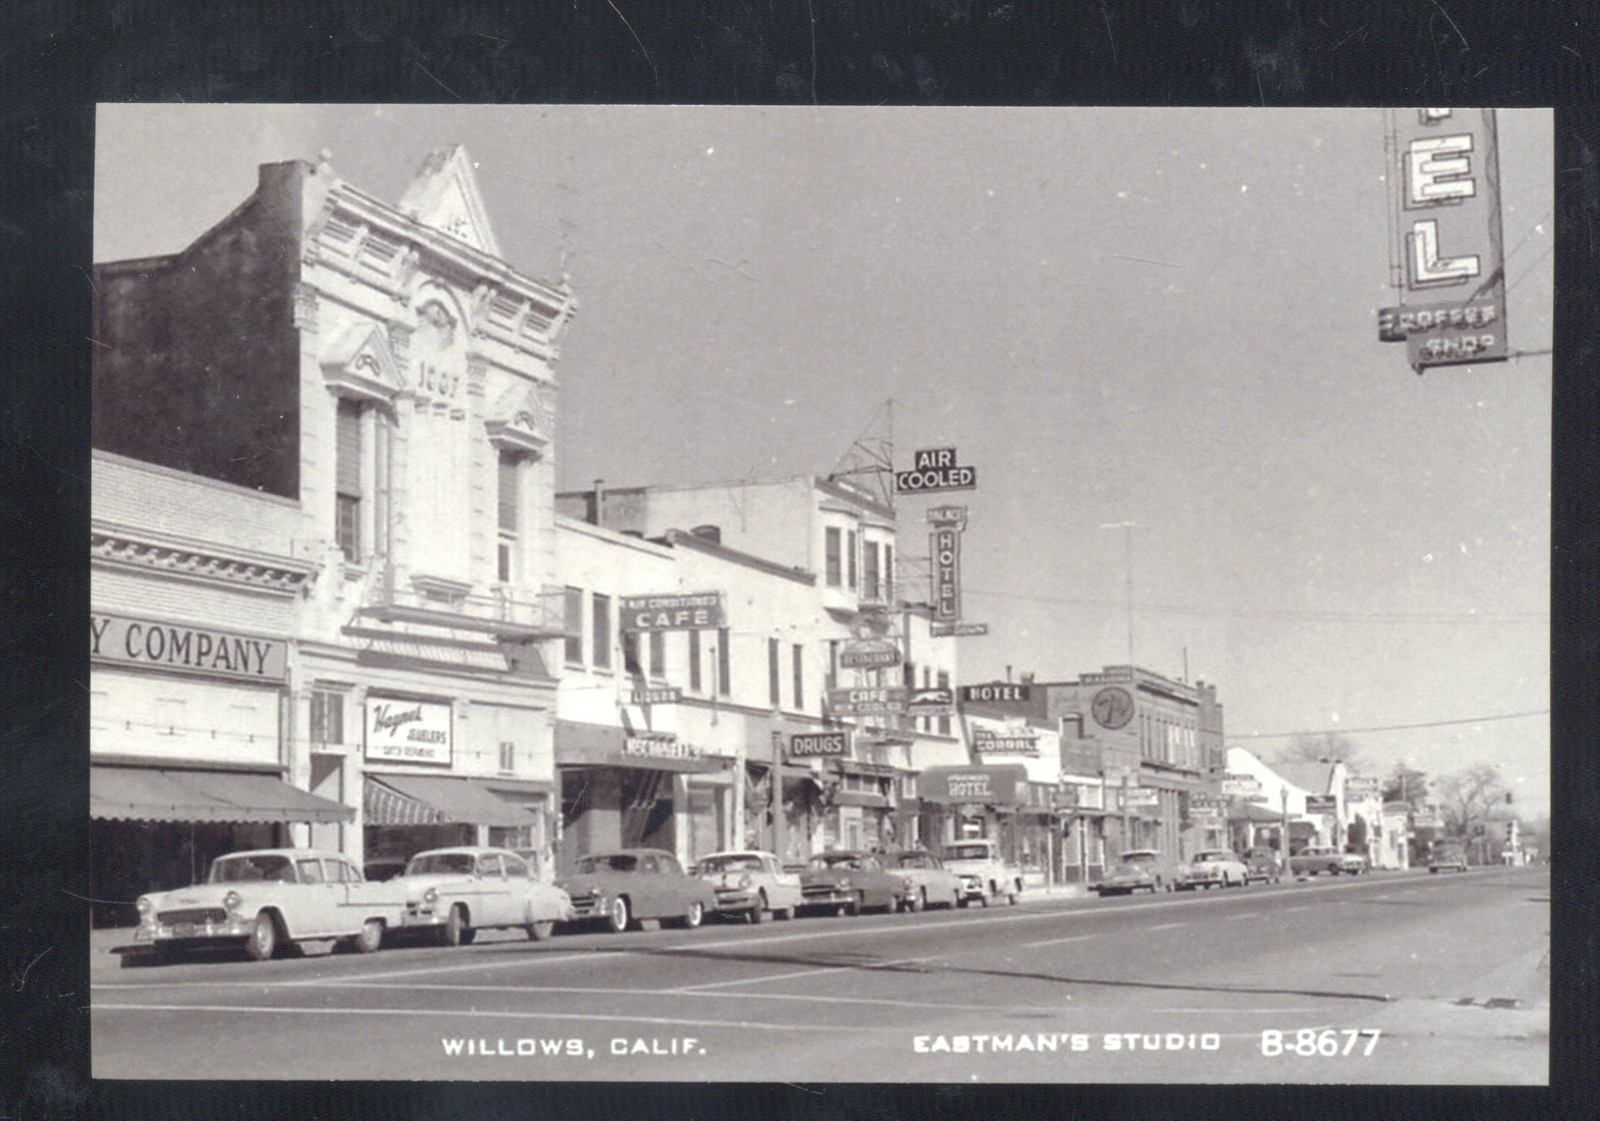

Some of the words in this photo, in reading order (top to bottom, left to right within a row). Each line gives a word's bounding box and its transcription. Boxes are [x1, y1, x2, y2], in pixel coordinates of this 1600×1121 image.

[918, 451, 951, 469] AIR
[899, 469, 971, 488] COOLED
[940, 533, 953, 615] HOTEL
[636, 609, 708, 627] CAFE
[125, 622, 272, 675] COMPANY
[850, 690, 888, 703] CAFE
[970, 687, 1024, 700] HOTEL
[794, 735, 842, 753] DRUGS
[949, 782, 994, 797] HOTEL
